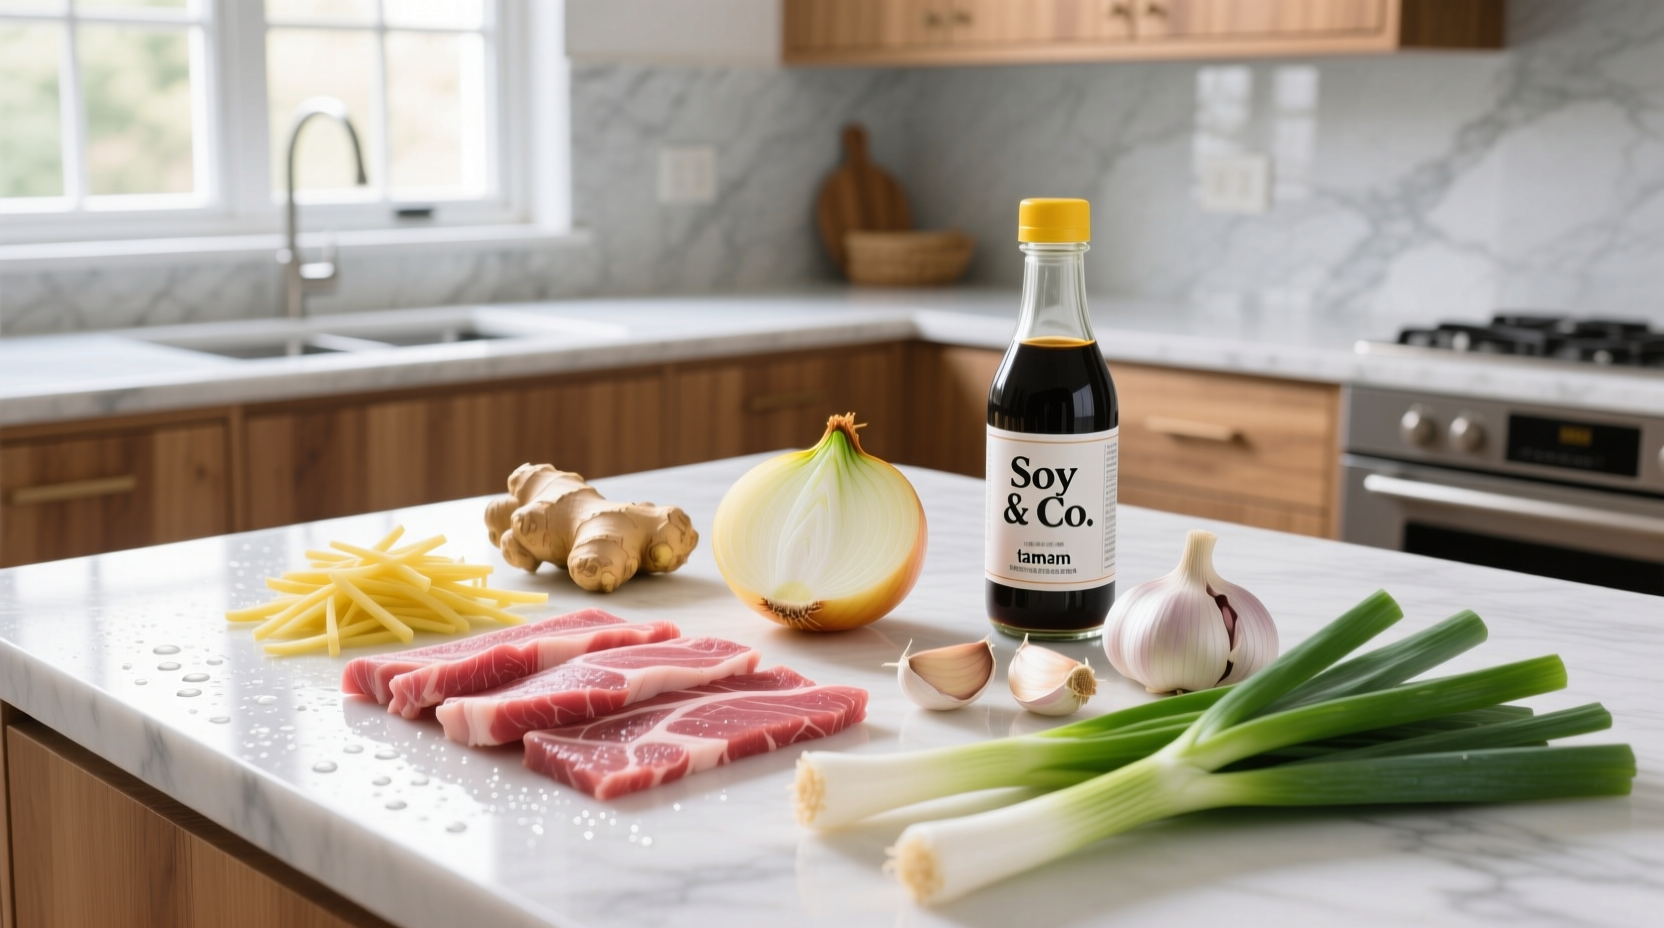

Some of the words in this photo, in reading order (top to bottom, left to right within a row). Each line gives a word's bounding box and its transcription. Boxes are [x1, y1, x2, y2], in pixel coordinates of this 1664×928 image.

[1010, 455, 1079, 497] Soy
[1003, 492, 1029, 526] &
[1036, 496, 1094, 528] Co.
[1016, 548, 1071, 566] tamam
